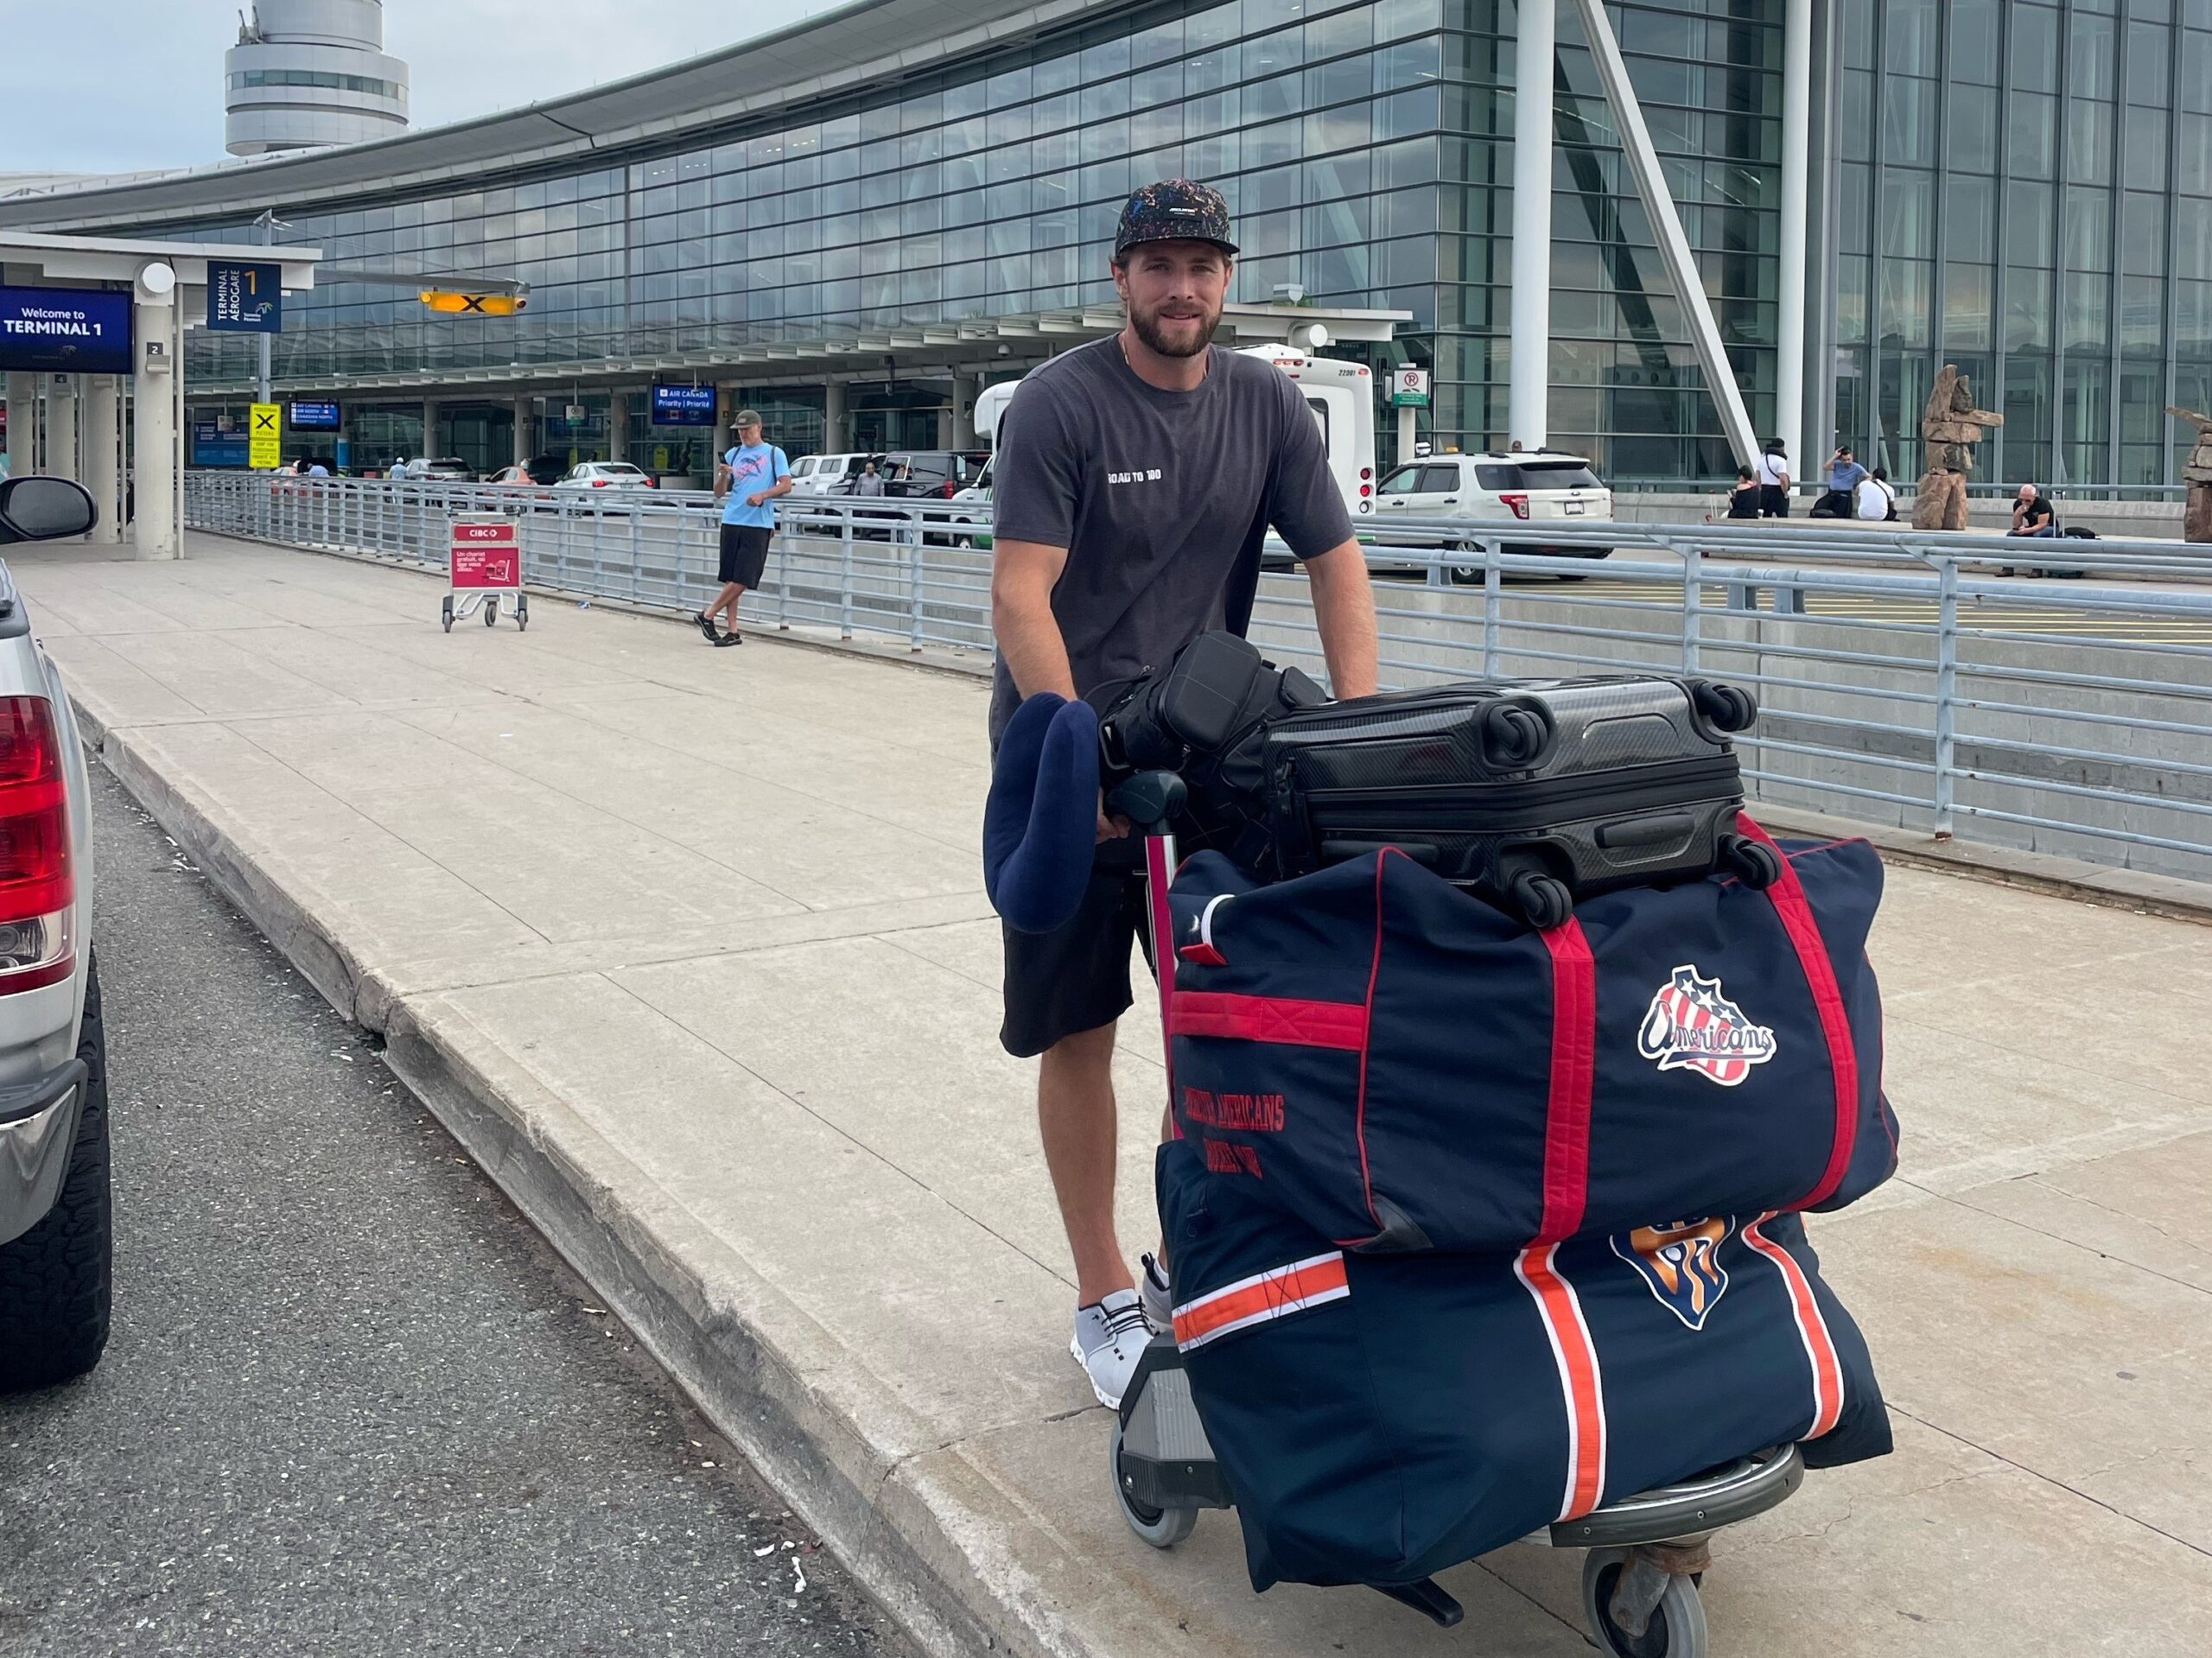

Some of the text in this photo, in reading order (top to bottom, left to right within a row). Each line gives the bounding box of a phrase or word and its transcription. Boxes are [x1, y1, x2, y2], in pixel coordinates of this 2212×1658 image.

[245, 270, 256, 295] 1
[218, 269, 228, 321] TERMINAL
[229, 270, 240, 321] AÉROGARE
[22, 308, 85, 320] Welcome to
[3, 320, 102, 336] TERMINAL 1
[151, 346, 159, 354] 2
[658, 399, 709, 409] Priority Priorité
[1132, 472, 1144, 482] TO
[1642, 1001, 1773, 1056] Americans
